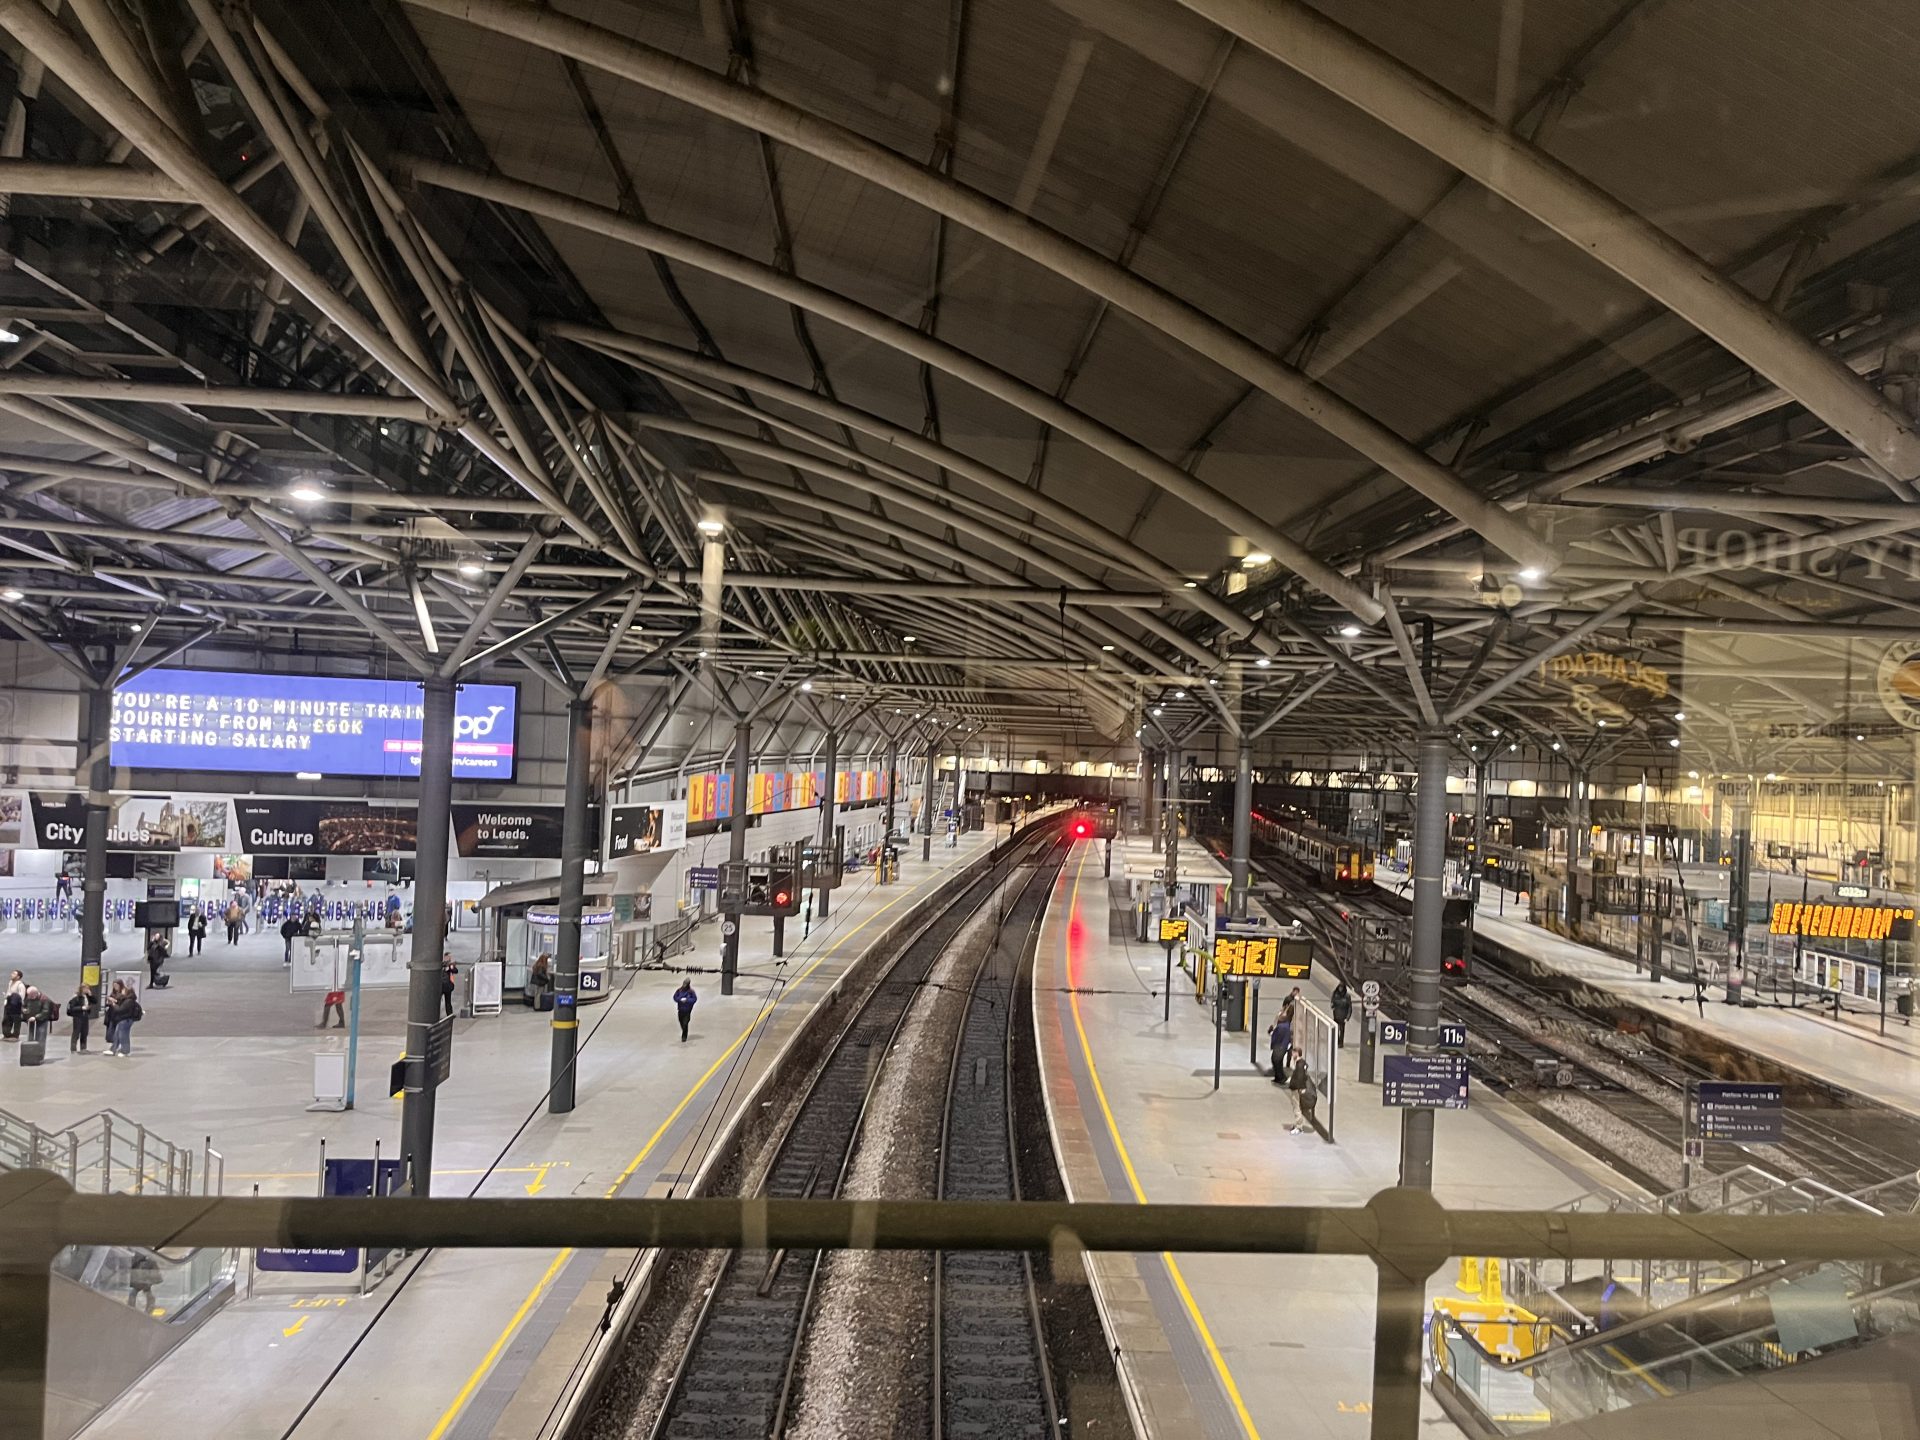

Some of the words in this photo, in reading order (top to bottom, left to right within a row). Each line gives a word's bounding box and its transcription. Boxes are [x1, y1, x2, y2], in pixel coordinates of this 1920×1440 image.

[113, 692, 191, 709] YOU'RE
[206, 696, 219, 711] A
[235, 697, 259, 713] 10
[273, 699, 350, 716] MINUTE
[366, 703, 424, 720] TRAIN
[110, 711, 204, 728] JOURNEY
[219, 714, 272, 731] FROM
[286, 717, 298, 732] A
[313, 719, 363, 734] £60K
[453, 706, 505, 740] pp
[110, 727, 217, 746] STARTING
[232, 732, 310, 749] SALARY
[477, 814, 532, 826] Welcome
[46, 823, 84, 844] City
[106, 825, 150, 842] uides
[250, 828, 314, 846] Culture
[477, 828, 489, 839] to
[492, 828, 529, 840] Leeds.
[614, 834, 628, 850] Food
[583, 975, 597, 988] 8b
[1365, 983, 1377, 993] 25
[1384, 1025, 1402, 1040] 9b
[1444, 1028, 1463, 1043] 11b
[298, 1248, 310, 1256] your
[329, 1248, 346, 1257] ready
